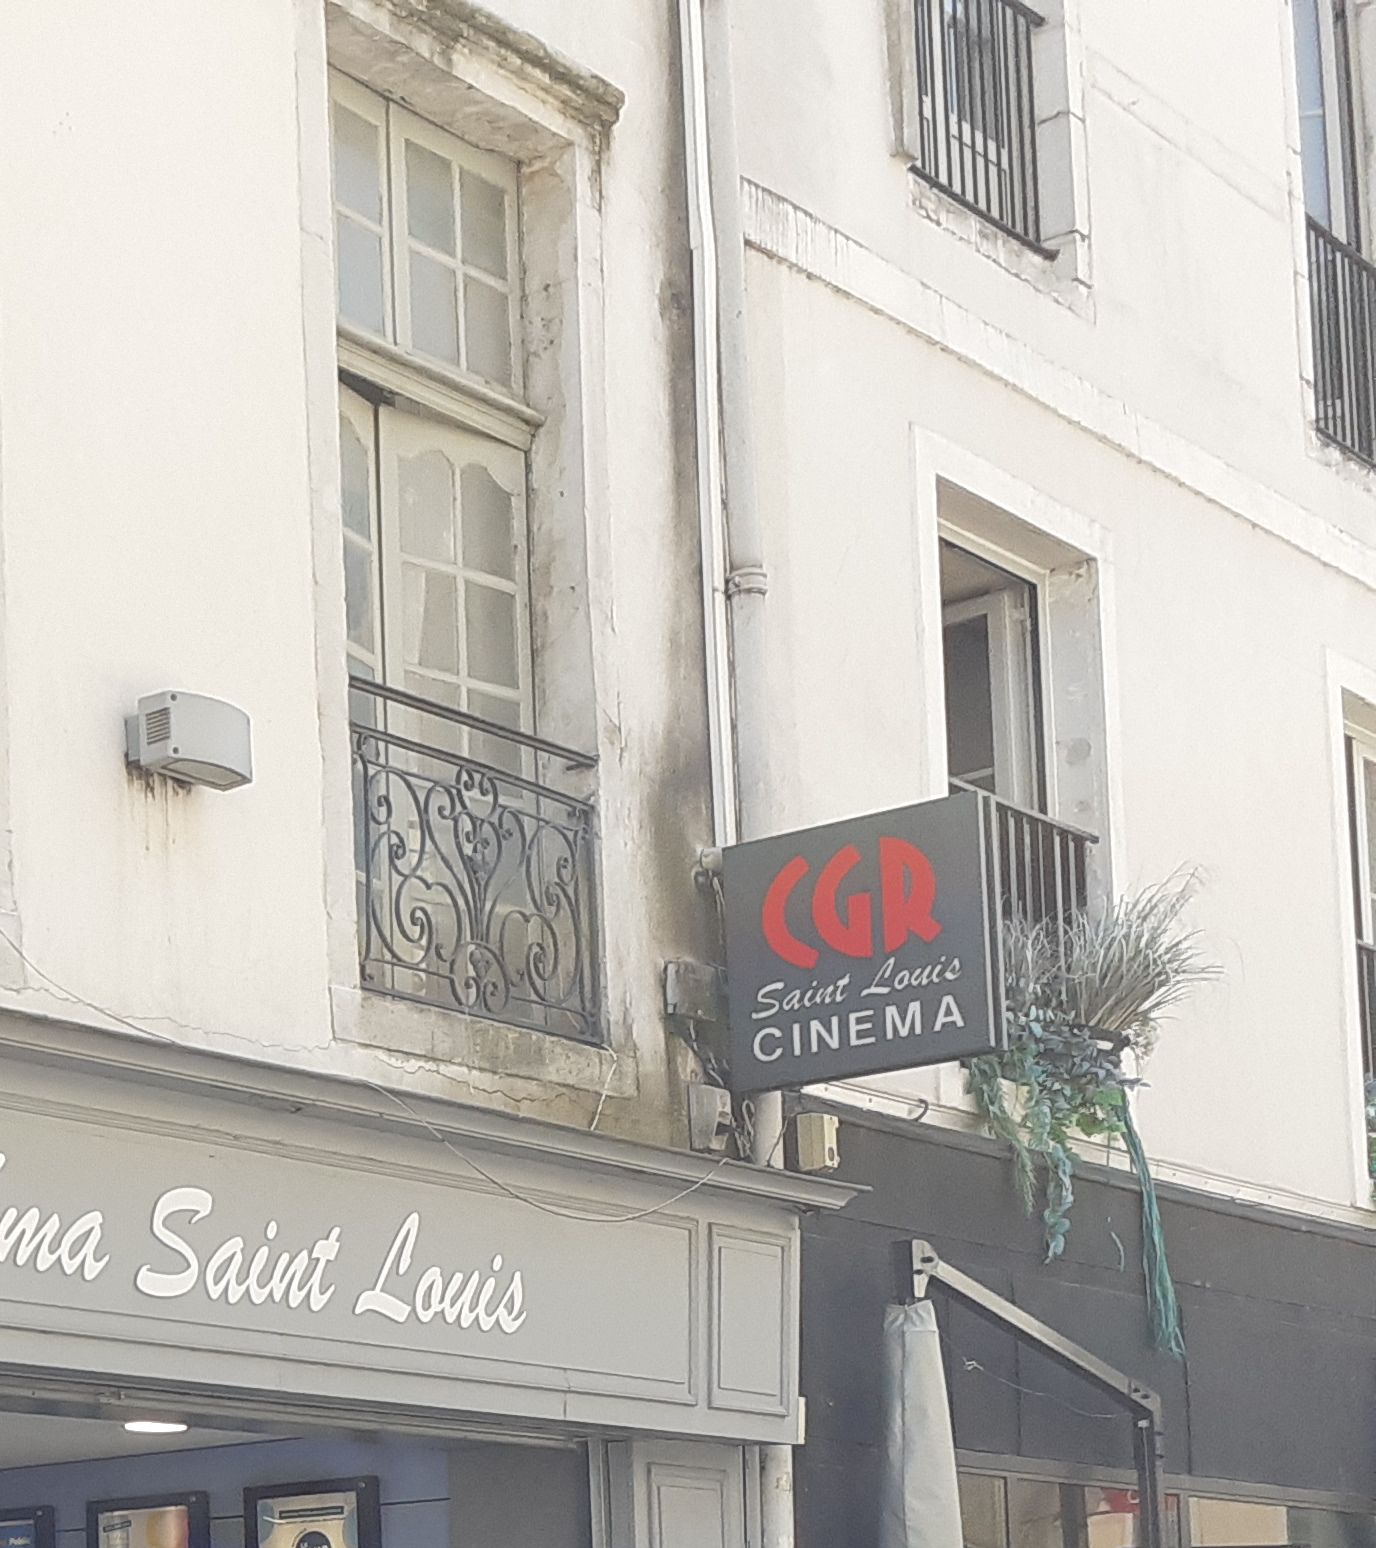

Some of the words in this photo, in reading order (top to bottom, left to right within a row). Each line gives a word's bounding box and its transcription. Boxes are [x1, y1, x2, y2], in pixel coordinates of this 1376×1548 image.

[761, 835, 943, 970] CGR
[751, 972, 850, 1020] Saint
[860, 955, 962, 997] Louis
[752, 994, 965, 1062] CINEMA
[136, 1186, 342, 1313] Saint
[354, 1210, 528, 1334] Louis
